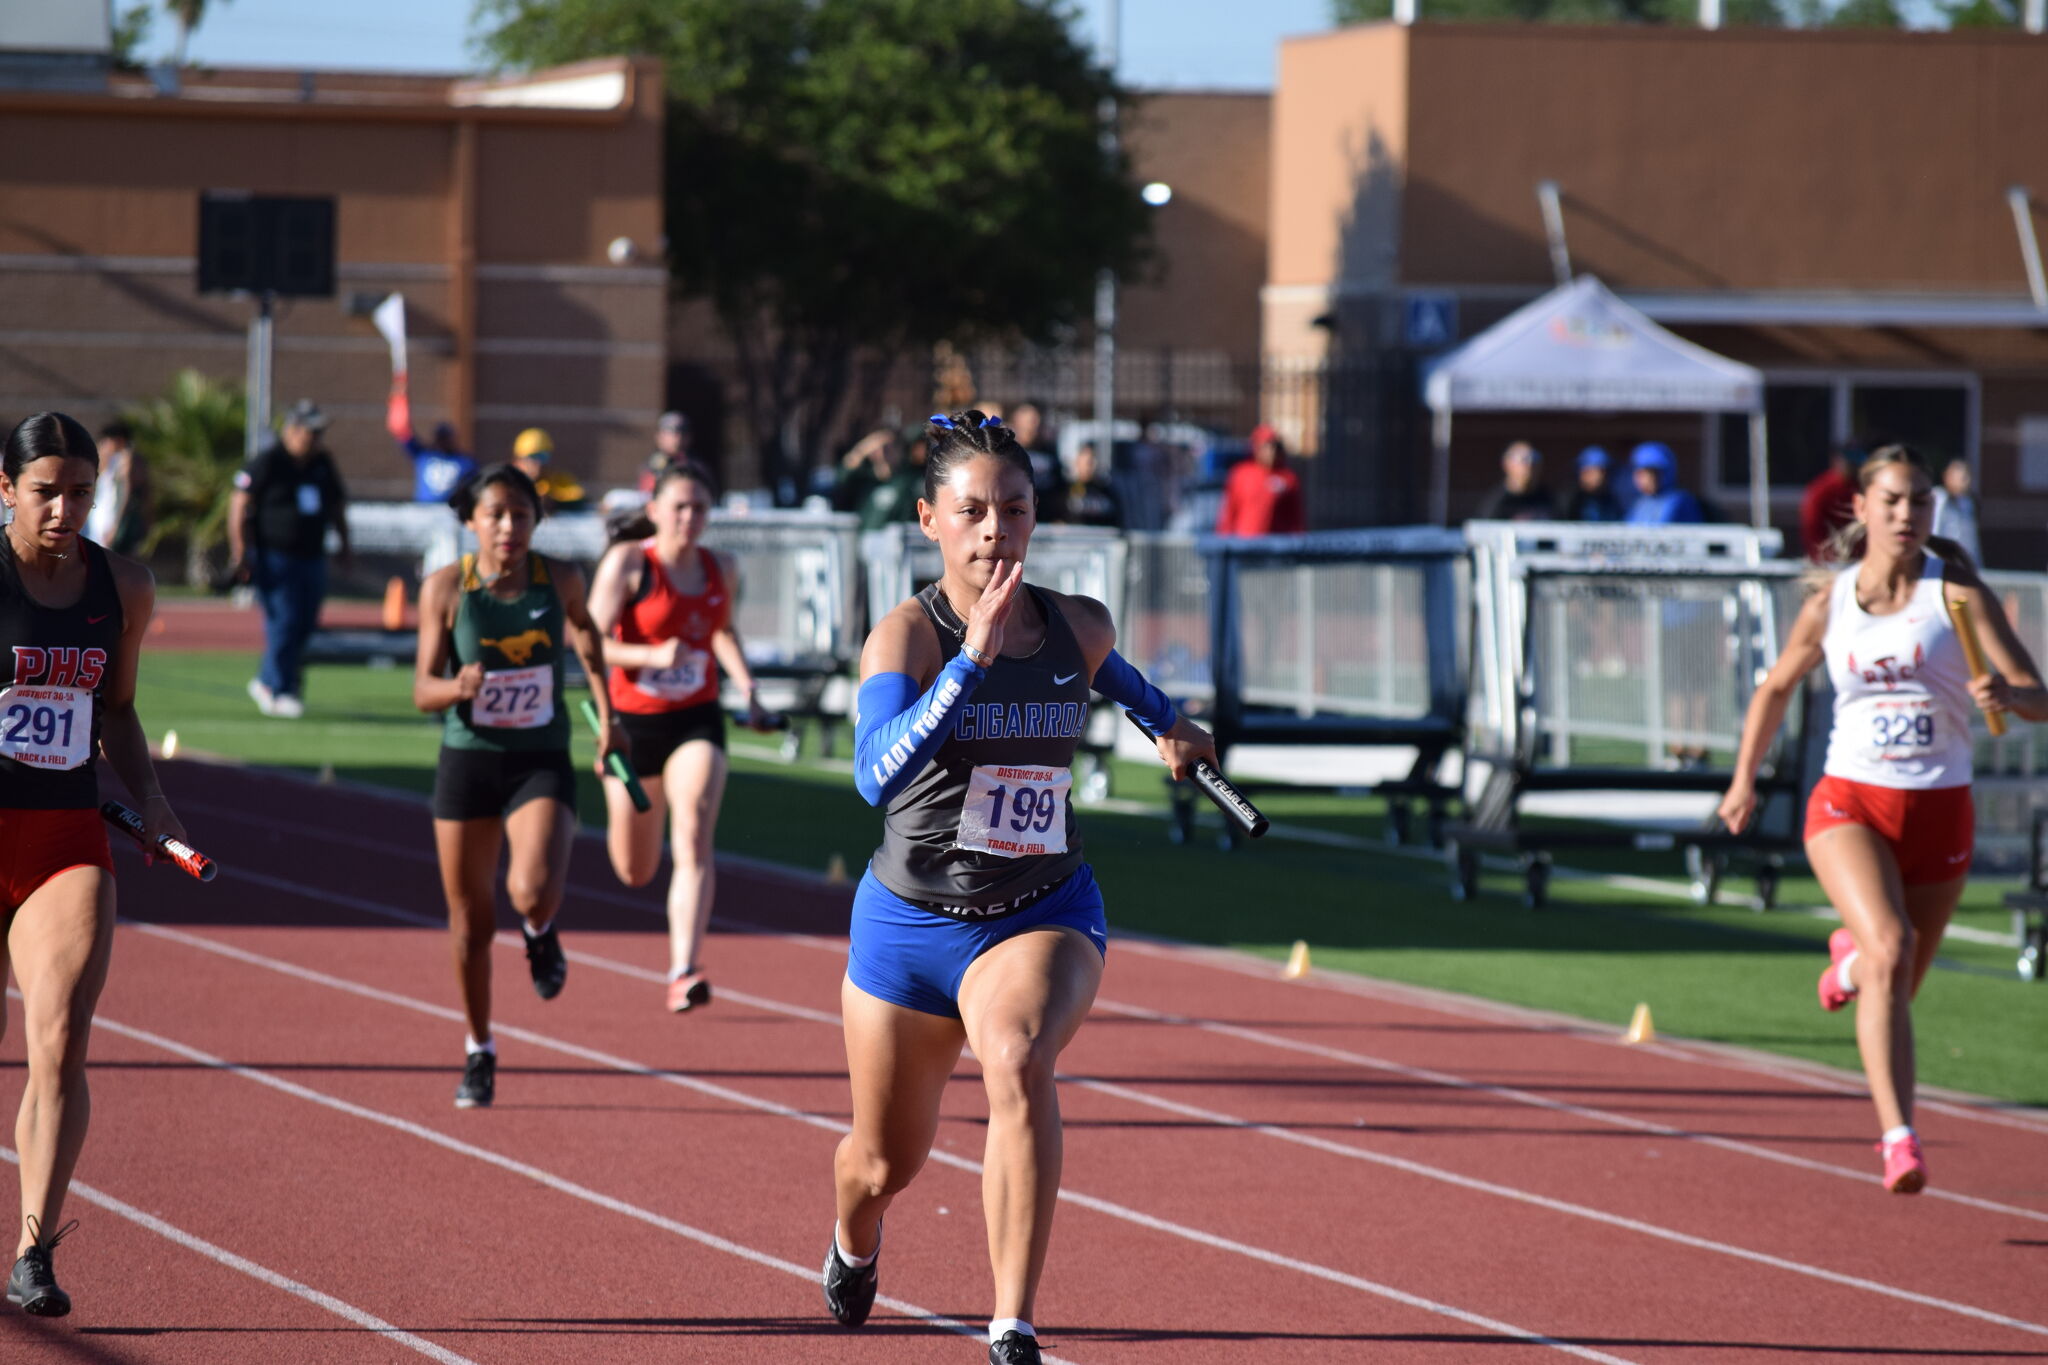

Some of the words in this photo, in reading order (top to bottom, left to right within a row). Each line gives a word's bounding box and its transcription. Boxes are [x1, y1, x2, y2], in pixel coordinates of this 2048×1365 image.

[12, 646, 107, 688] PHS
[16, 690, 52, 700] DISTRICT
[486, 682, 540, 713] 272
[5, 704, 74, 748] 291
[872, 732, 916, 787] LADY
[911, 678, 962, 740] TOROS
[955, 702, 1086, 741] CIGARROA
[1873, 714, 1935, 746] 329
[14, 752, 40, 764] TRACK
[48, 755, 67, 766] FIELD
[997, 767, 1033, 781] DISTRICT
[1033, 771, 1053, 782] 30-5A
[987, 784, 1055, 833] 199
[1213, 779, 1259, 821] FEARLESS
[987, 839, 1018, 852] TRACK
[1018, 844, 1025, 853] &
[1025, 844, 1046, 854] FIELD
